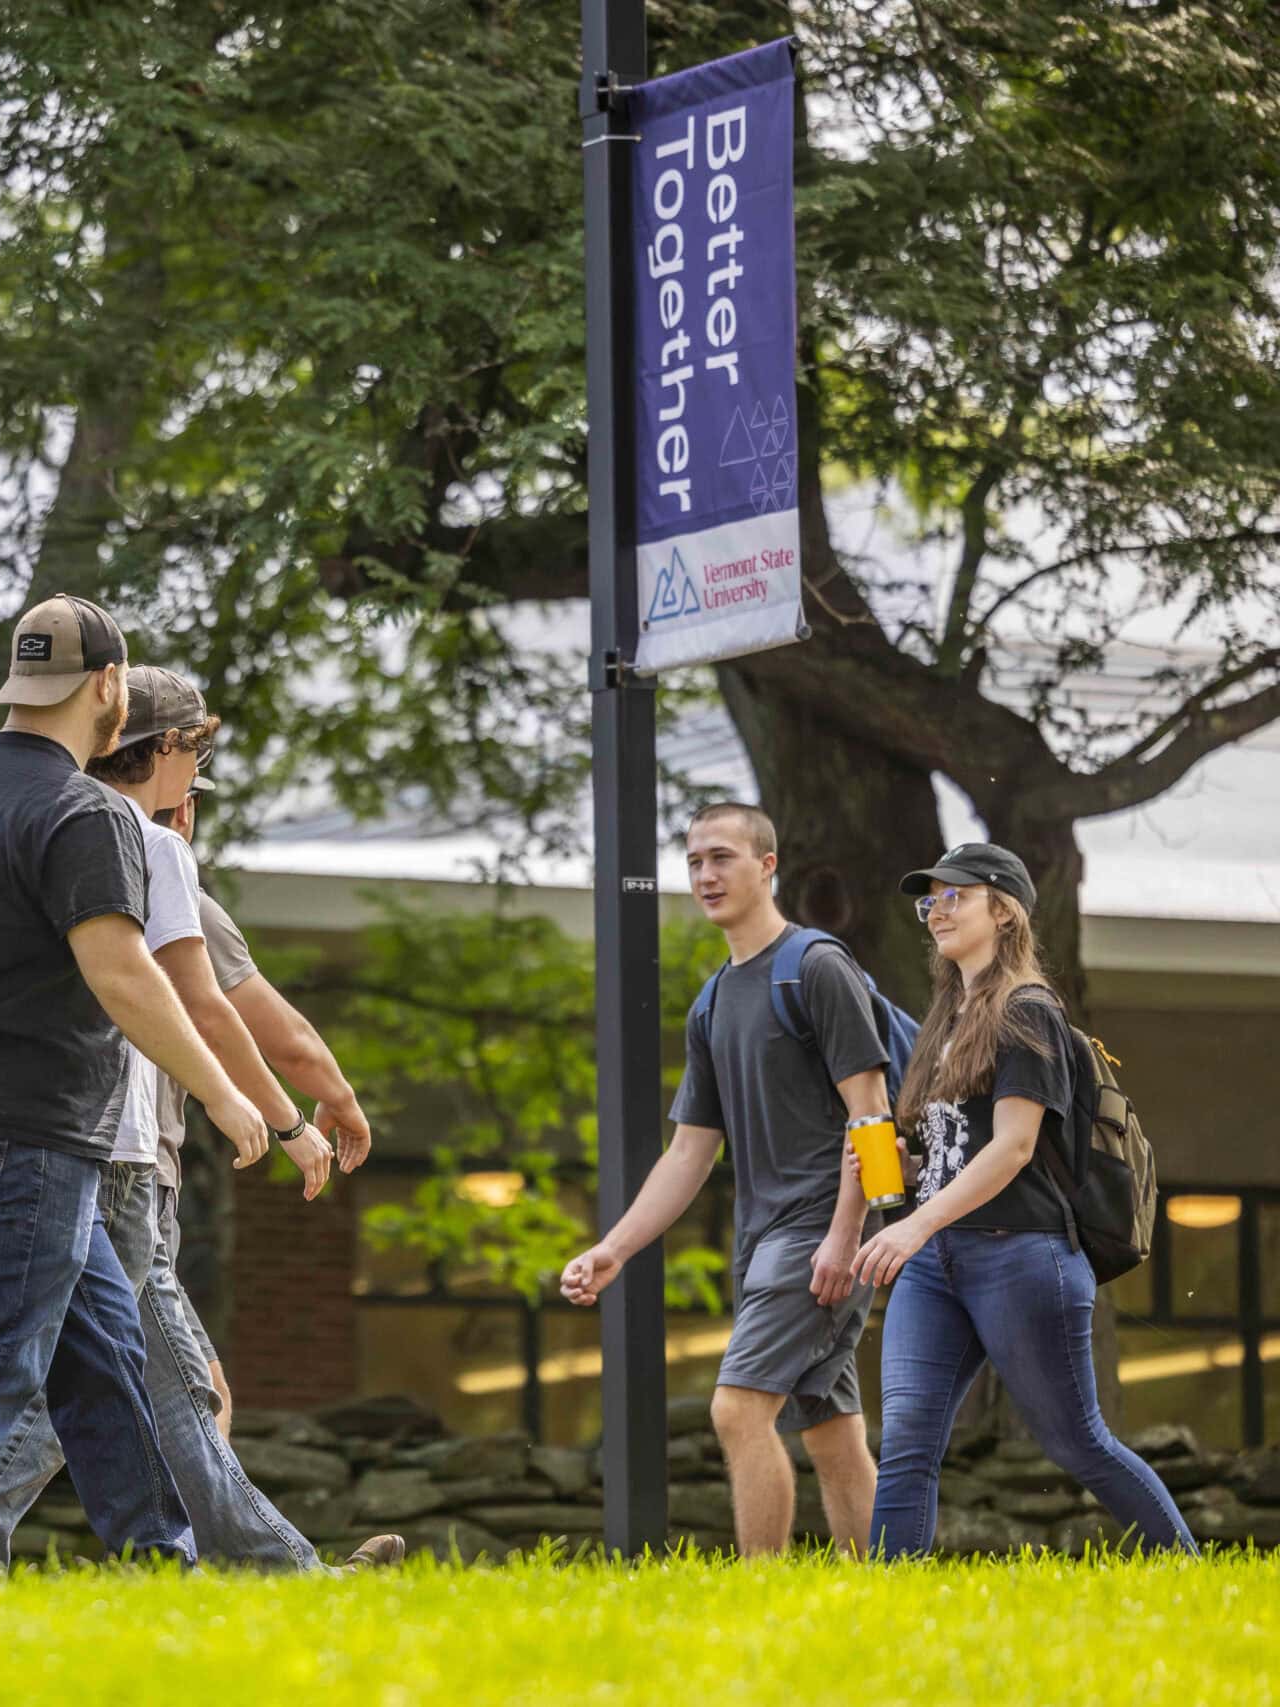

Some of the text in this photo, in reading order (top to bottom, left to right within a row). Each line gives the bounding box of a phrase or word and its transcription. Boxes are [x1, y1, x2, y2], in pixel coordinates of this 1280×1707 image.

[648, 115, 695, 512] Together
[706, 106, 747, 387] Better
[703, 547, 794, 585] Vermont State
[703, 578, 768, 609] University
